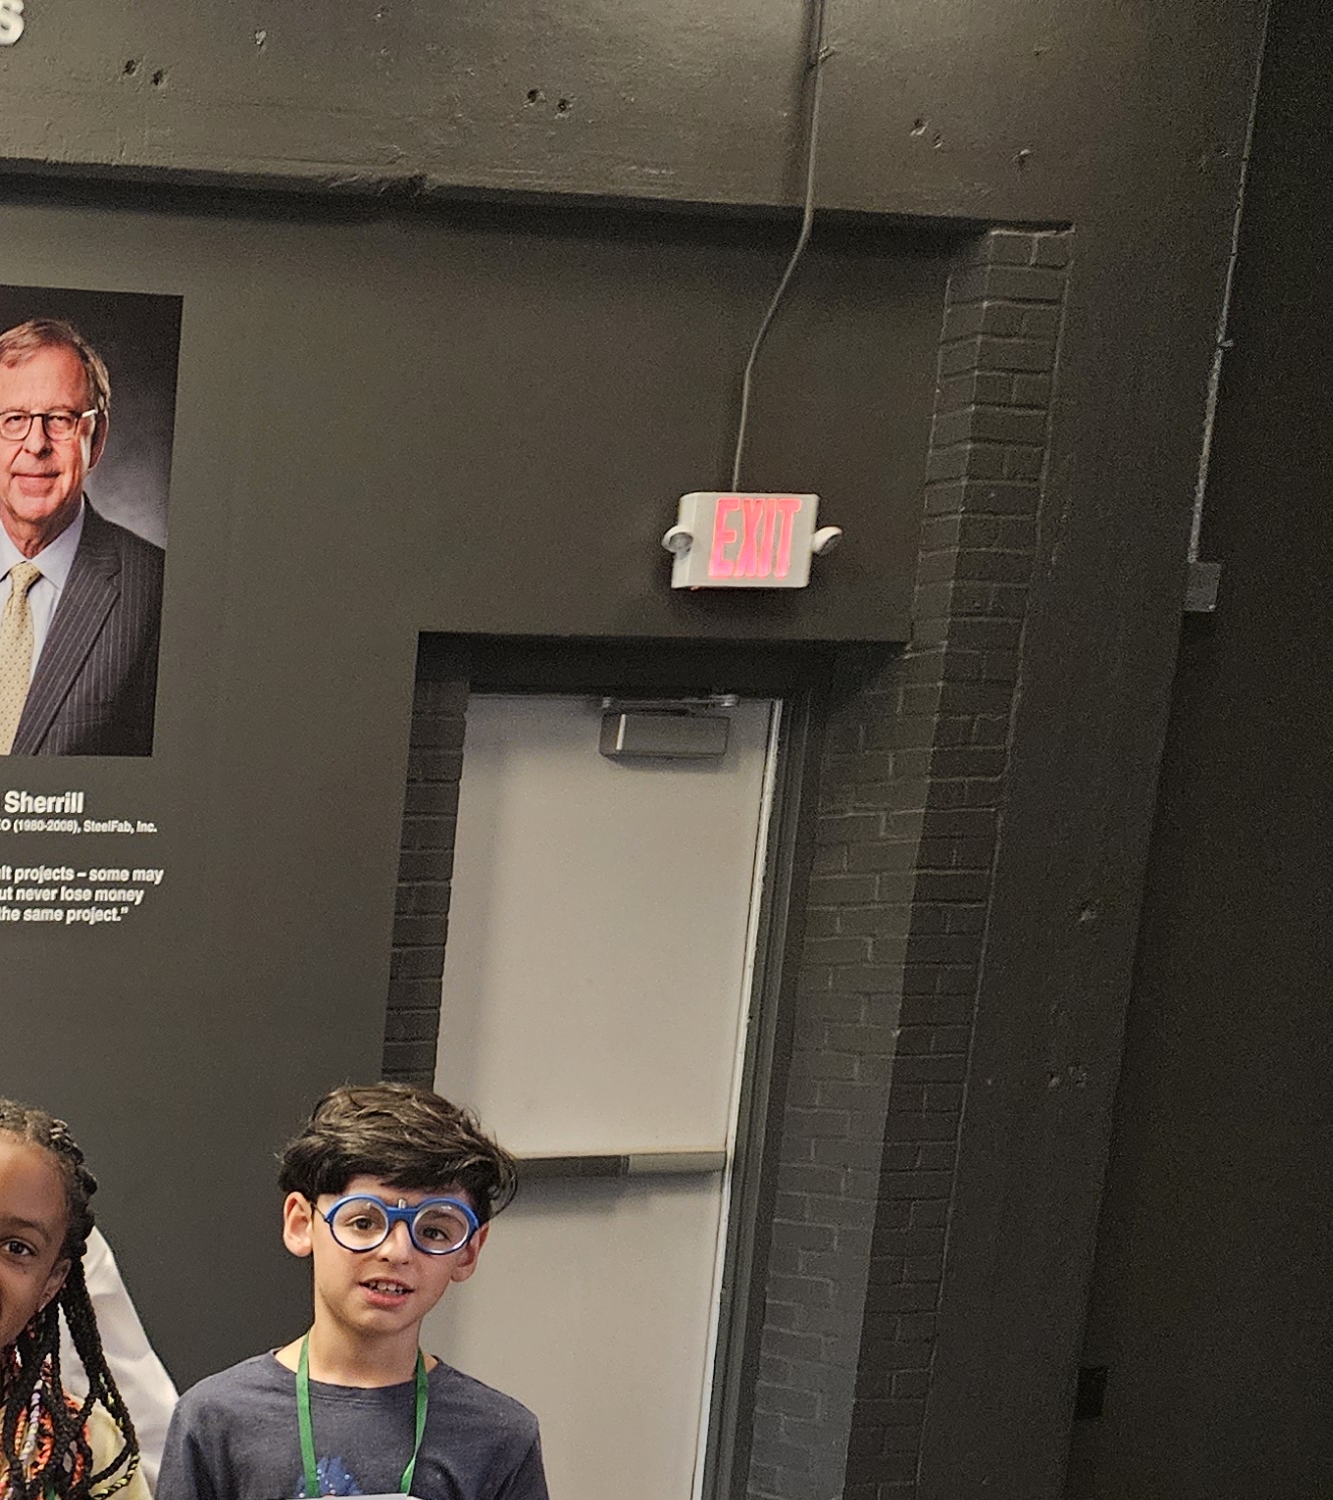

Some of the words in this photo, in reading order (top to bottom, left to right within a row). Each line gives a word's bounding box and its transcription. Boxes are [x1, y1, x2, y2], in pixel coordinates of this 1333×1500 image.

[708, 497, 802, 579] EXIT
[4, 791, 85, 814] Sherrill
[83, 820, 135, 834] SteelFab,
[136, 821, 158, 833] Inc.
[14, 865, 75, 884] projects
[88, 868, 130, 882] some
[132, 869, 164, 885] may
[15, 888, 59, 901] never
[60, 886, 93, 902] lose
[94, 889, 145, 906] money
[23, 909, 64, 922] same
